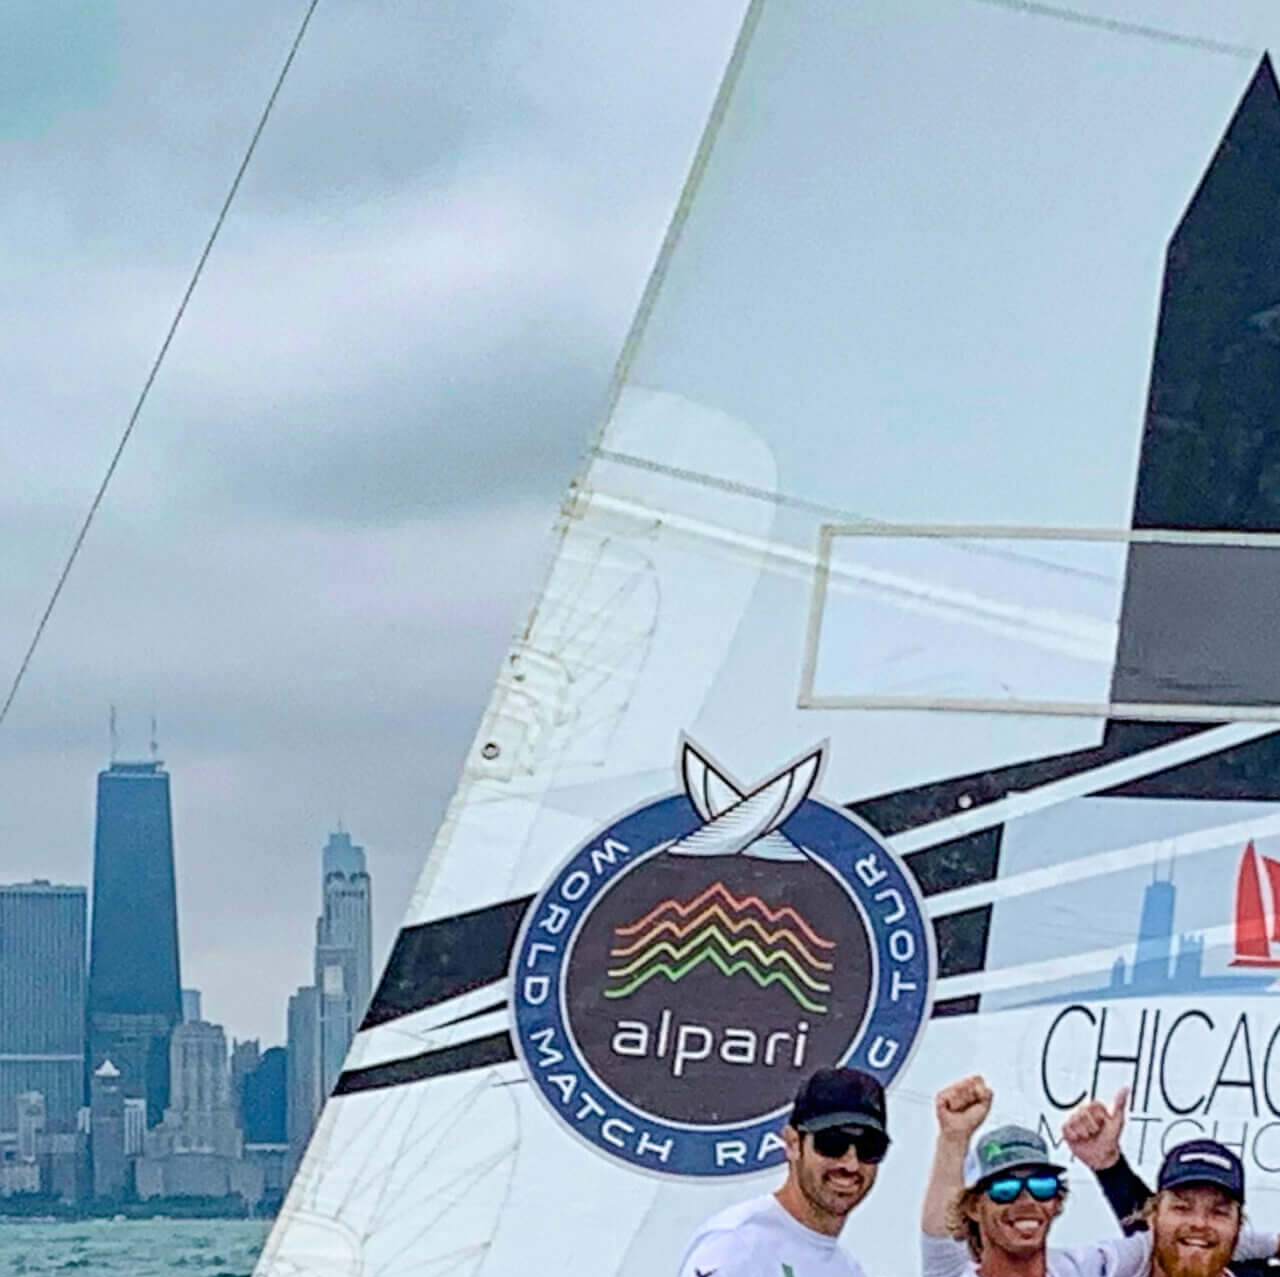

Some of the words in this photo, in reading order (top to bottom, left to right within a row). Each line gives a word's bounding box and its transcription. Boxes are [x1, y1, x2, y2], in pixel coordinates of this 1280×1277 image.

[524, 838, 631, 1005] WORLD
[855, 852, 917, 1001] TOUR
[530, 1026, 673, 1163] MATCH
[612, 1009, 809, 1076] alpari
